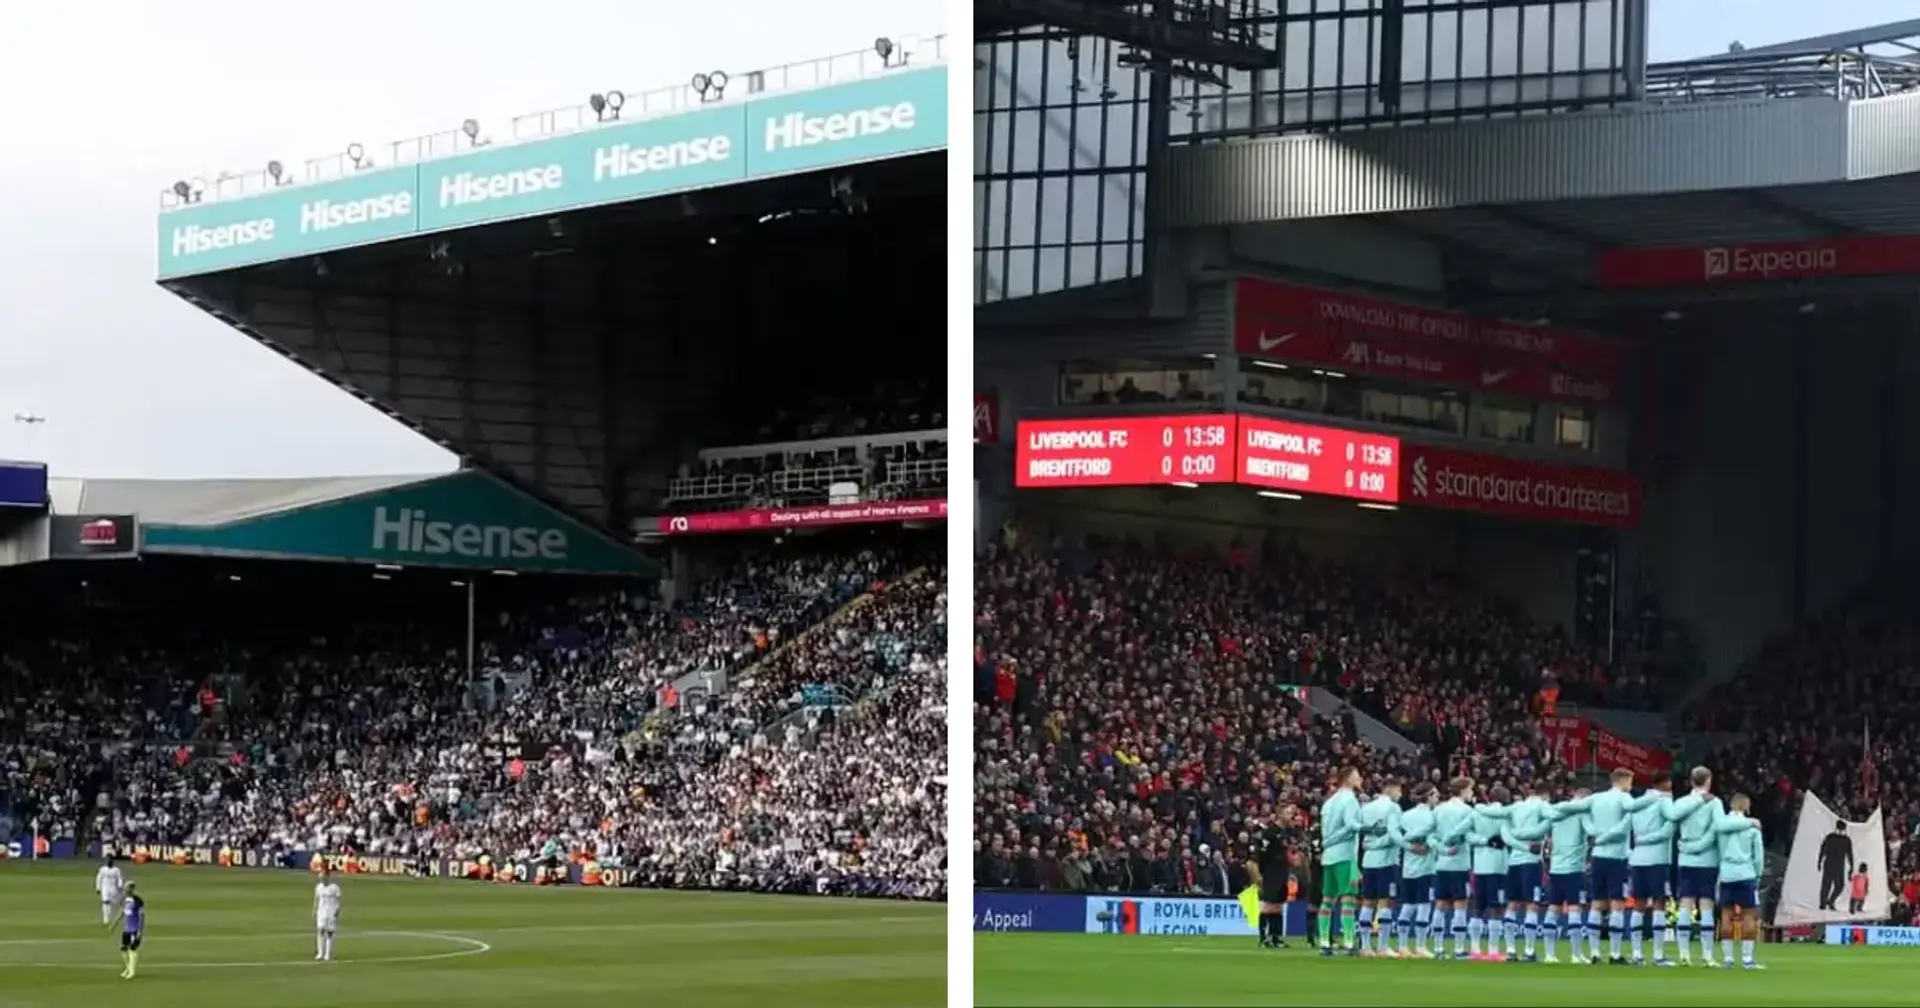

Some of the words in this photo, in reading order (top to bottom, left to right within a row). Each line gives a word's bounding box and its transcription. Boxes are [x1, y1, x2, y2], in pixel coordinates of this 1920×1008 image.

[765, 101, 916, 152] Hisense
[593, 135, 731, 182] Hisense
[439, 163, 563, 208] Hisense
[300, 190, 412, 234] Hisense
[172, 217, 276, 257] Hisense
[1734, 248, 1837, 279] Expedia
[1029, 430, 1106, 450] LIVERPOOL
[1109, 429, 1128, 448] FC
[1162, 427, 1172, 447] 0
[1184, 426, 1226, 447] 13:58
[1247, 429, 1306, 455] LIVERPOOL
[1307, 437, 1323, 456] FC
[1346, 442, 1355, 461] 0
[1361, 445, 1393, 466] 13:58
[1029, 458, 1112, 478] BRENTFORD
[1161, 456, 1172, 475] 0
[1182, 455, 1215, 475] 0:00
[1345, 469, 1354, 488] 0
[1359, 471, 1385, 492] 0:00
[1434, 465, 1531, 505] standard
[1532, 479, 1630, 515] chartered
[770, 512, 800, 522] Dealing
[802, 509, 819, 519] with
[862, 507, 871, 517] of
[872, 506, 895, 516] Home
[897, 504, 930, 515] Finance
[372, 506, 568, 559] Hisense
[982, 907, 1033, 932] Appeal
[1153, 901, 1200, 918] ROYAL
[1877, 928, 1915, 940] ROYAL
